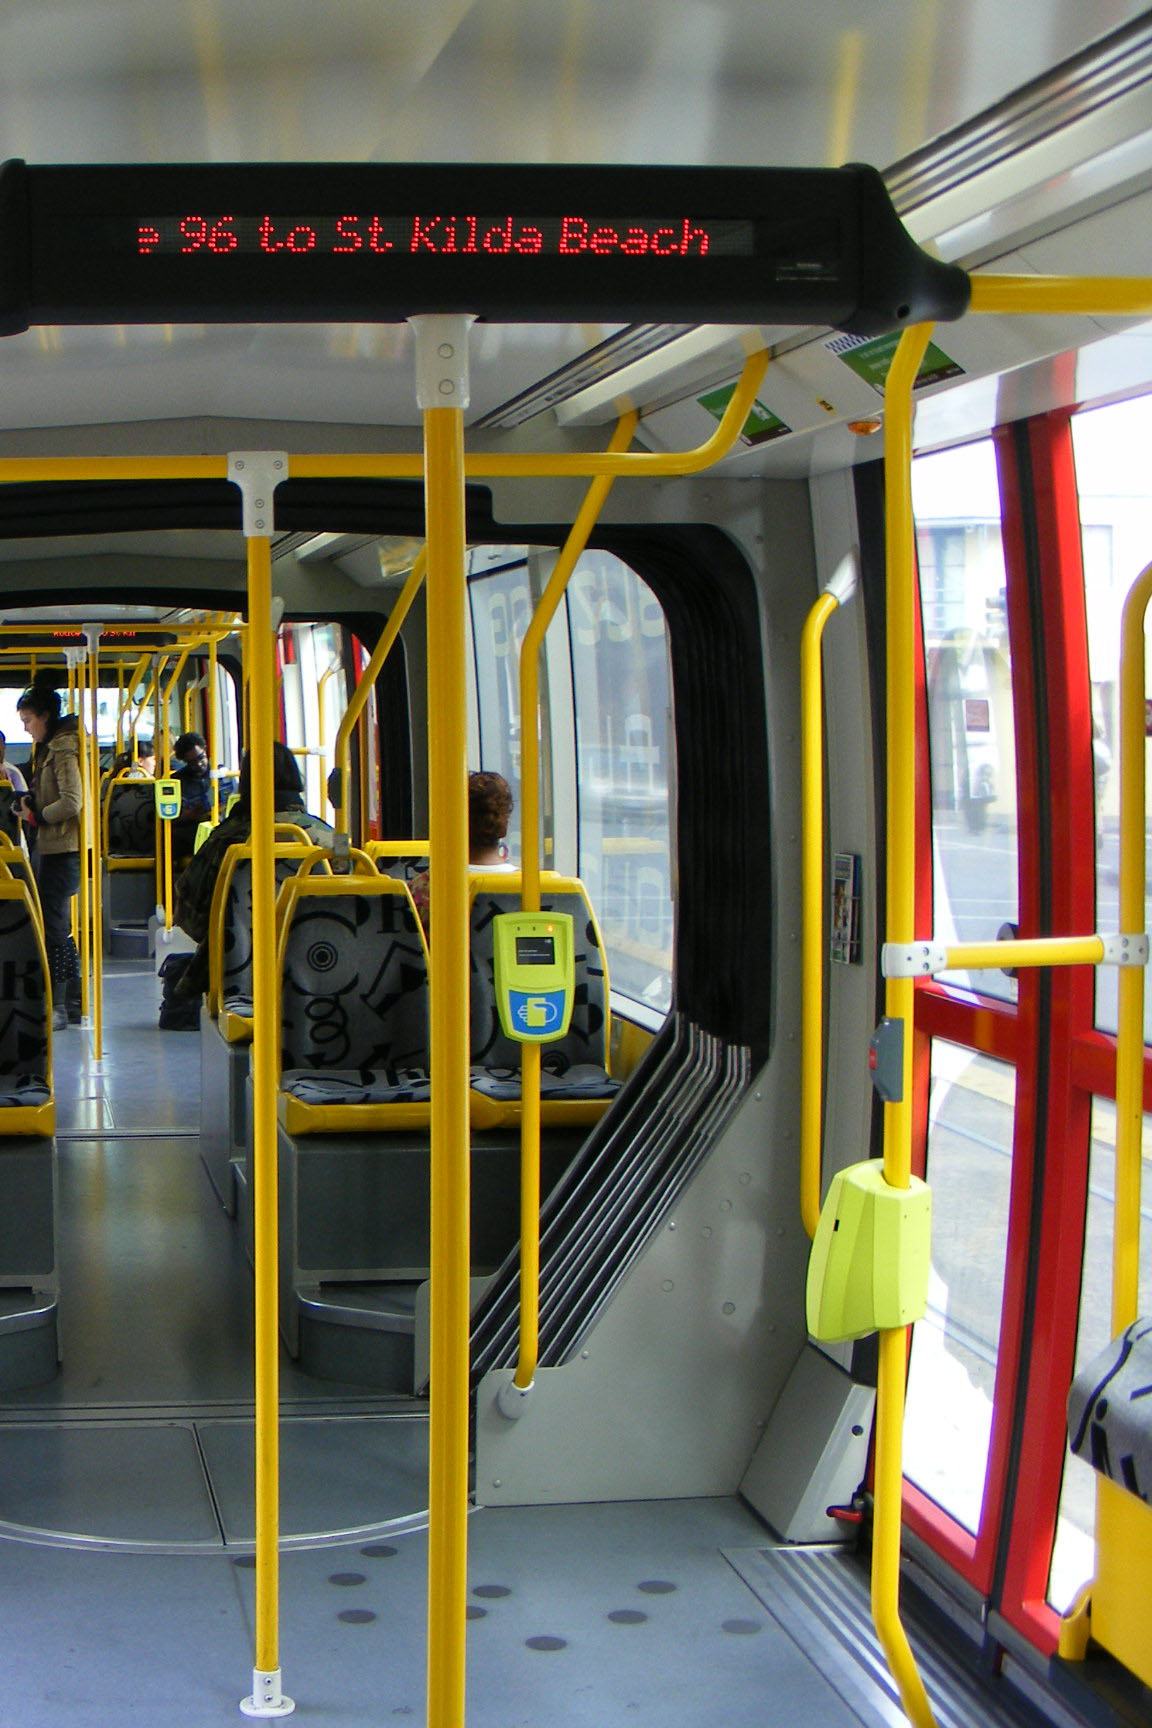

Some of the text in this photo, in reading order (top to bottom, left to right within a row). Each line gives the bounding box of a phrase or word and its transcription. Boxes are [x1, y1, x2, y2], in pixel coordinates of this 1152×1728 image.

[180, 215, 238, 253] 96
[258, 215, 316, 253] to
[333, 215, 393, 253] St
[410, 215, 543, 253] Kilda
[559, 215, 709, 255] Beach
